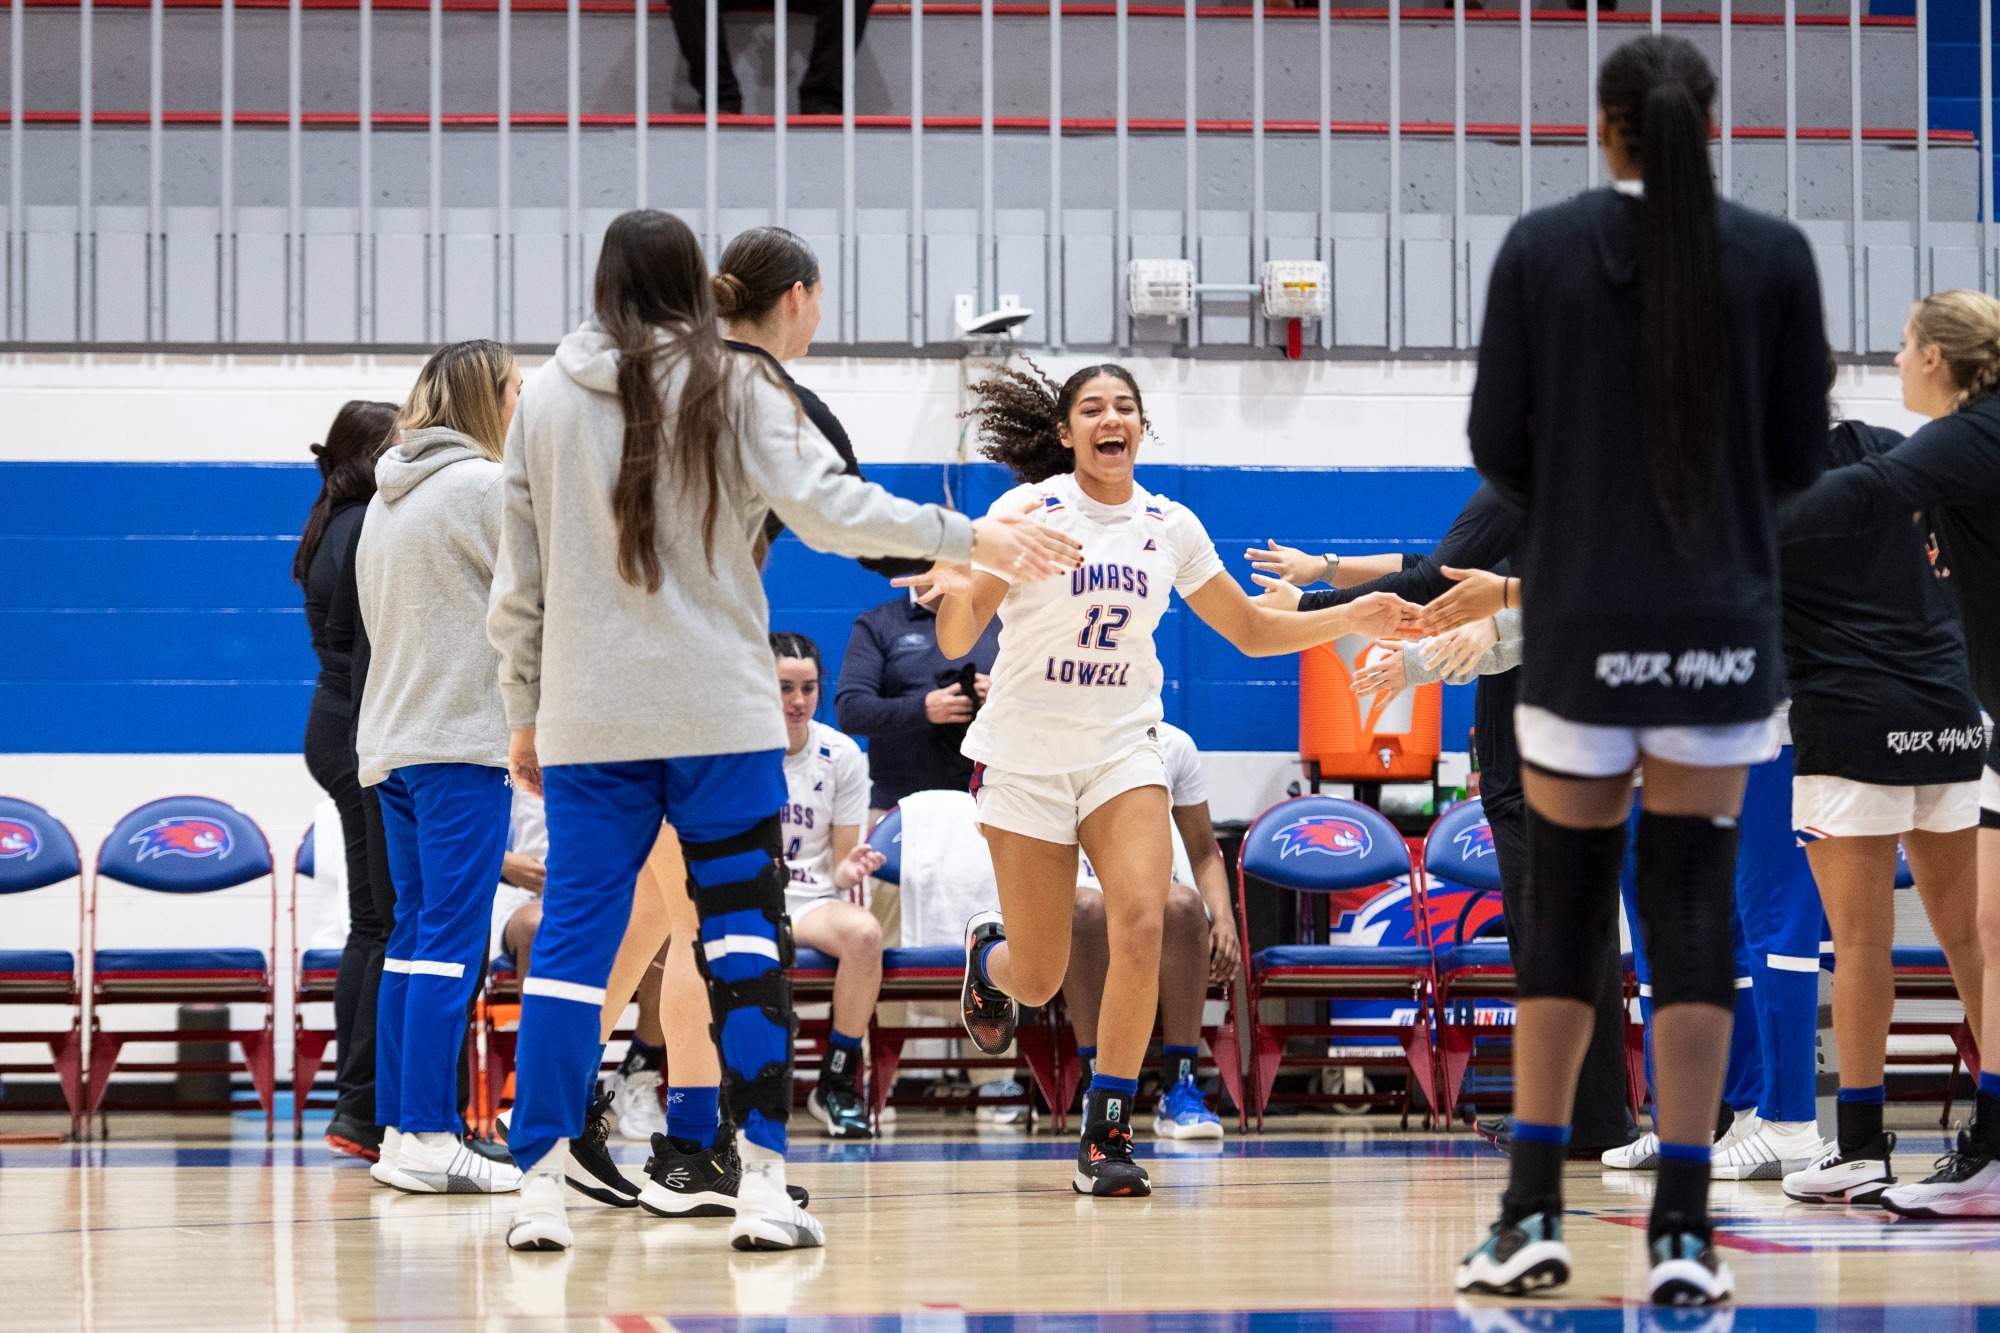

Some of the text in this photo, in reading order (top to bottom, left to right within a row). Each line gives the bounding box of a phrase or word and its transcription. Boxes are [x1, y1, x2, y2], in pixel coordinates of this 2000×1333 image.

[1071, 563, 1148, 599] UMASS
[1077, 605, 1132, 650] 12
[1045, 656, 1131, 687] LOWELL
[1595, 652, 1674, 689] RIVER
[1886, 724, 1983, 754] RIVER HAWKS
